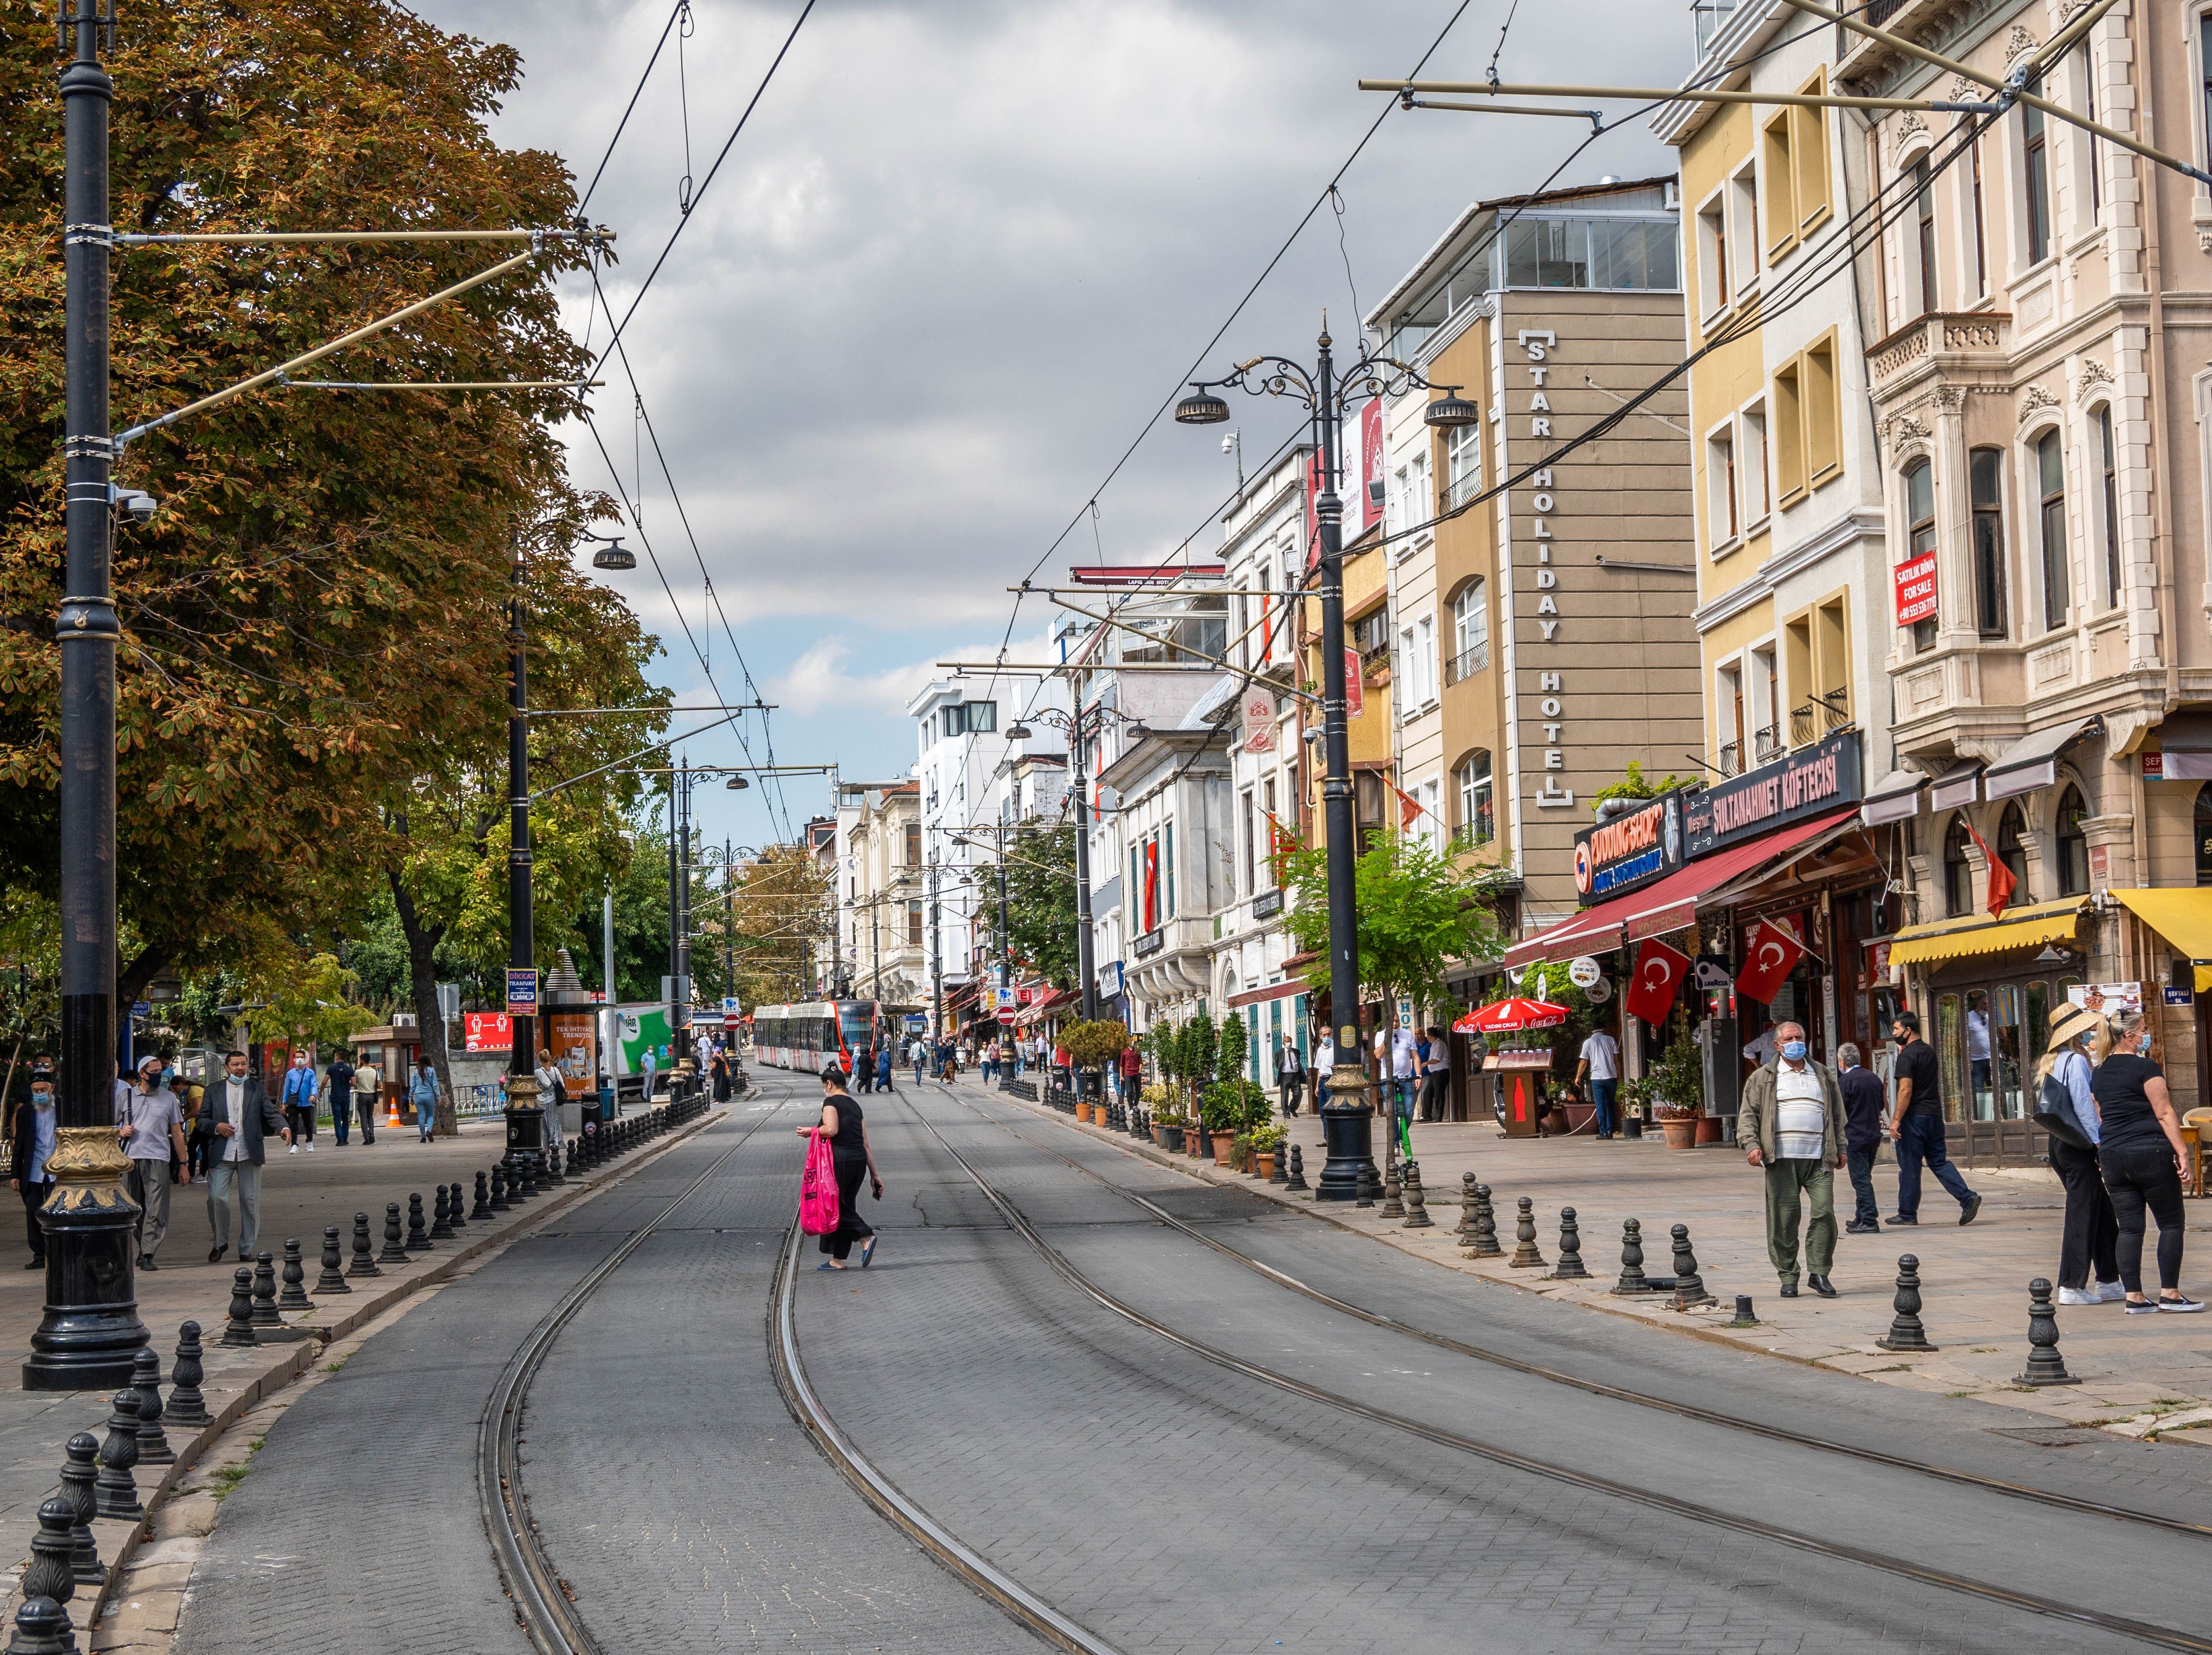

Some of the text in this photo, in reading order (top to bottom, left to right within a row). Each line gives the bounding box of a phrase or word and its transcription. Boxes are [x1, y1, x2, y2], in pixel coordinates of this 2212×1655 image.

[1528, 342, 1561, 795] STAR HOLIDAY HOTEL
[1897, 559, 1935, 584] SATILIK BİNA
[1904, 579, 1932, 601] FOR SALE
[1899, 607, 1909, 620] +90
[1909, 603, 1918, 617] 553
[2145, 757, 2162, 766] ŞEF
[1713, 775, 1780, 835] SULTANAHMET
[1781, 745, 1839, 810] KÖFTECİSİ
[1591, 817, 1630, 866] PUDDING
[2168, 989, 2189, 998] ŞEFTALİ
